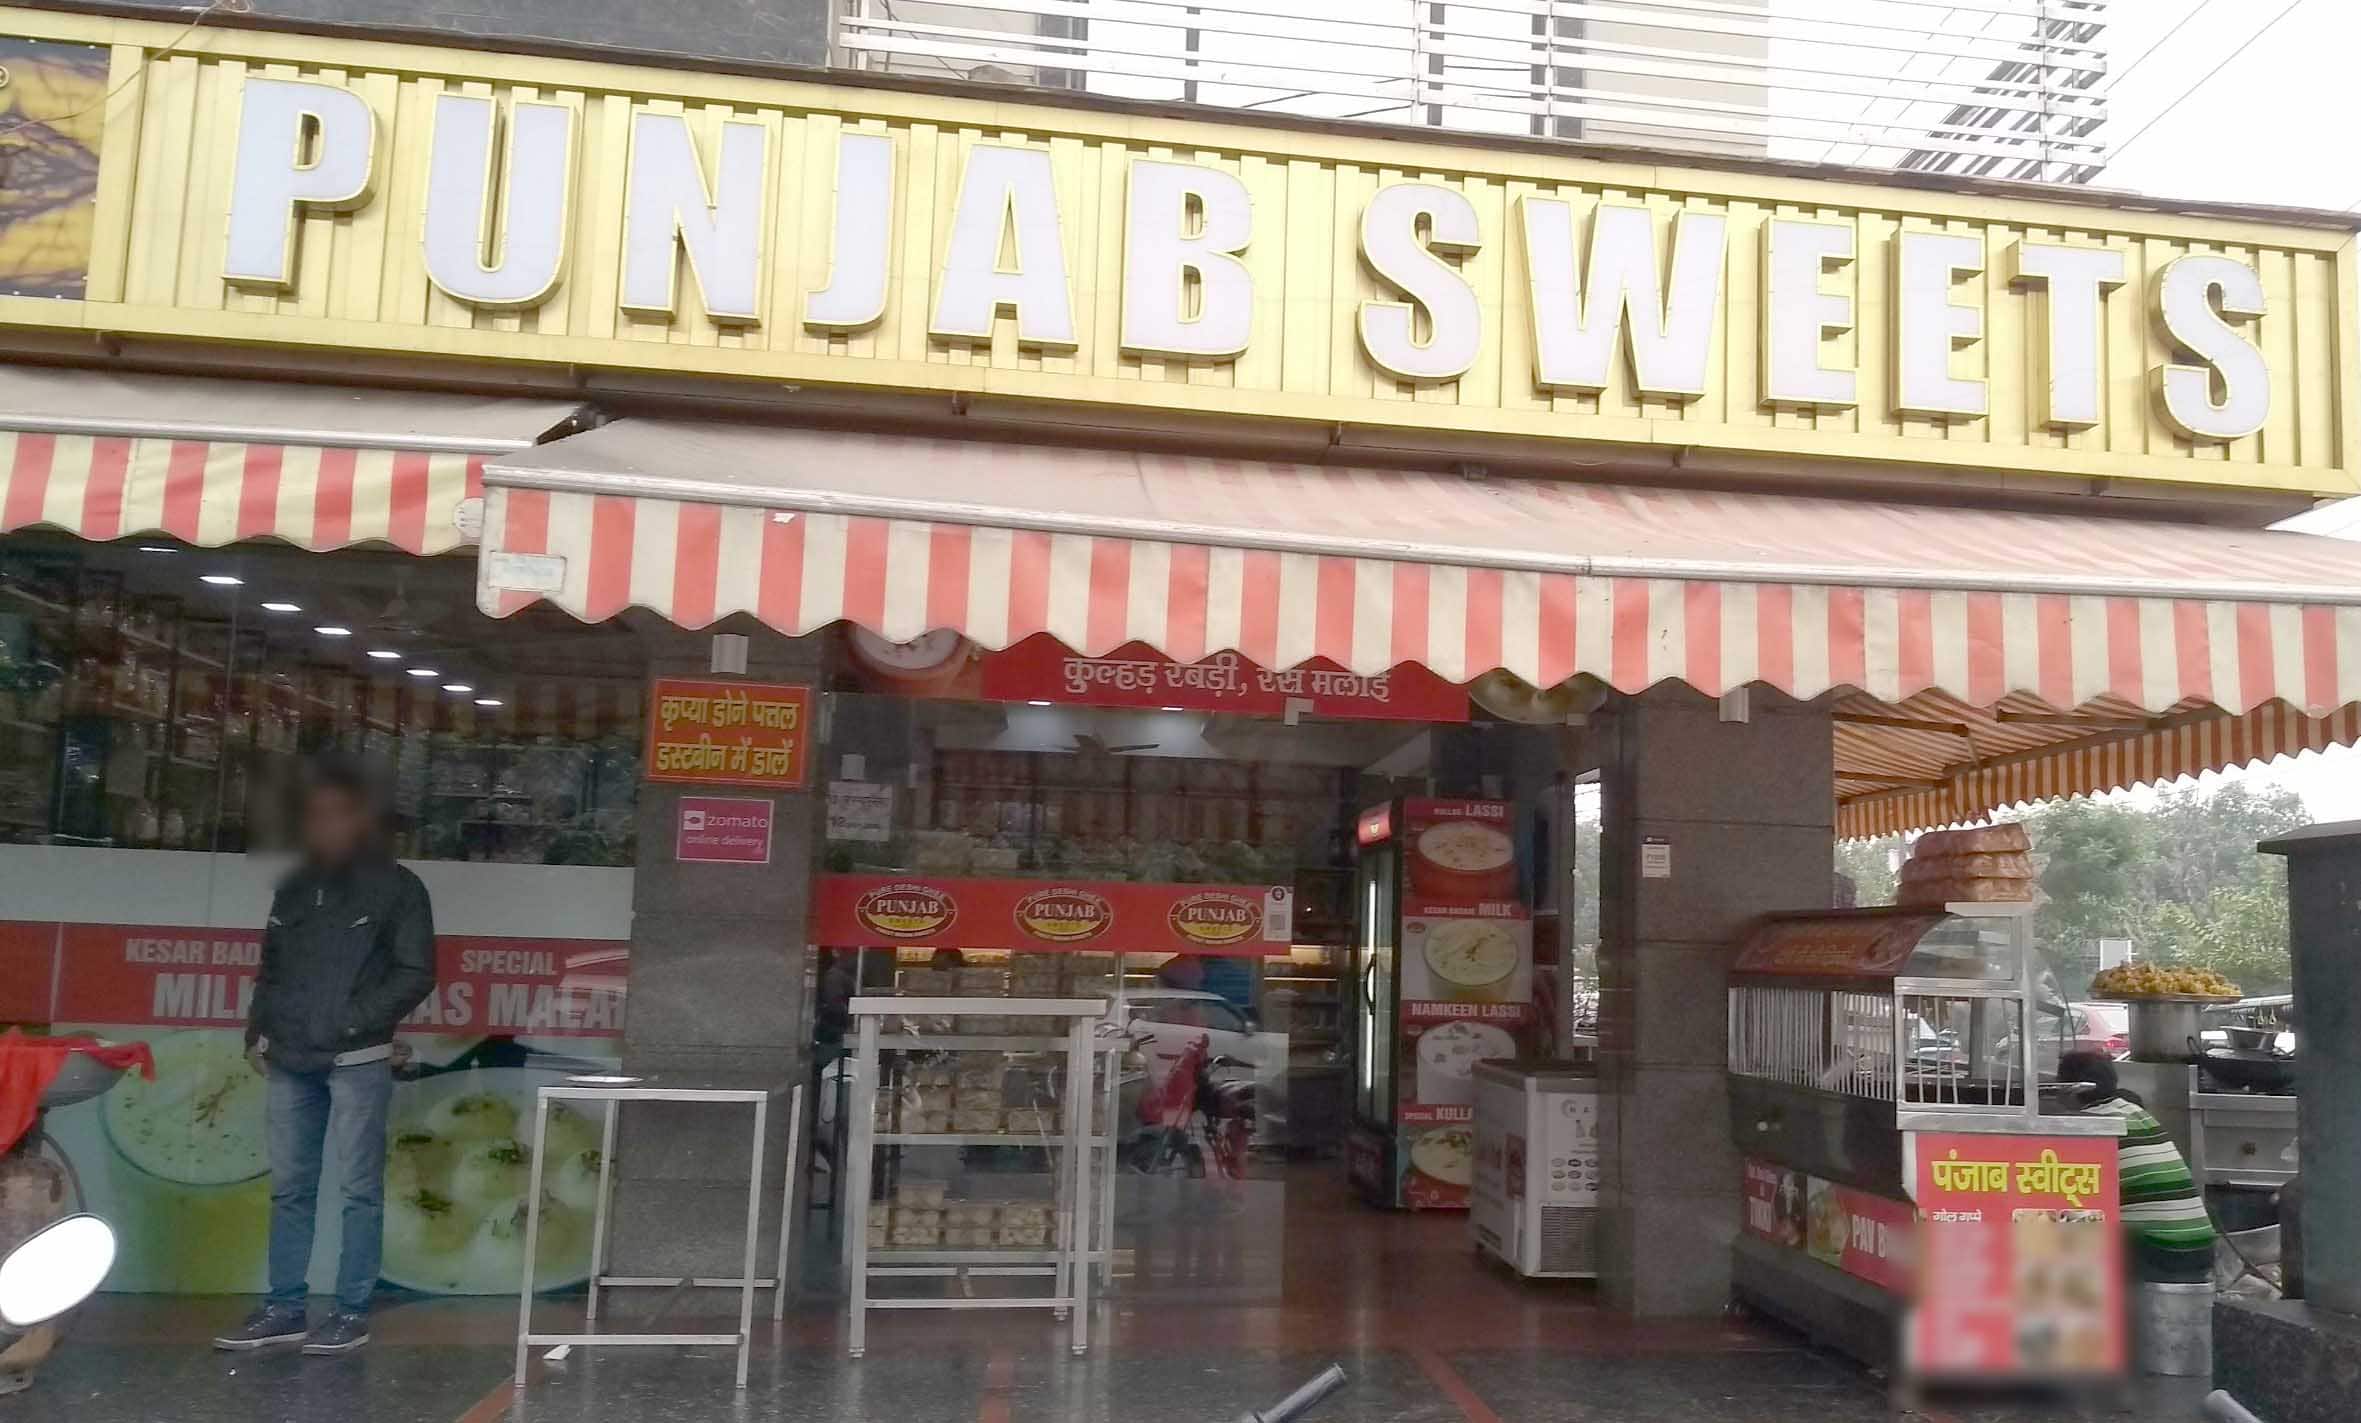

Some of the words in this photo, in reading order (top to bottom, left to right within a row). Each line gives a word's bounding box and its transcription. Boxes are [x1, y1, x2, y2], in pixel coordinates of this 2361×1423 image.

[221, 75, 1254, 358] PUNJAB
[1357, 182, 2271, 444] SWEETS
[1064, 657, 1158, 694] कुल्हड़
[1257, 668, 1304, 694] रस
[657, 733, 729, 770] डस्टबीन
[731, 736, 753, 771] में
[752, 738, 795, 776] डालें
[707, 815, 769, 829] zomato
[686, 834, 719, 846] online
[720, 834, 765, 850] delivery
[876, 899, 939, 915] PUNJAB
[1034, 903, 1096, 918] PUNJAB
[1187, 907, 1247, 923] PUNJAB
[1478, 903, 1512, 917] MILK
[126, 938, 205, 964] KESAR
[212, 941, 264, 966] BAD
[461, 950, 557, 976] SPECIAL
[400, 981, 474, 1027] AS
[1412, 1003, 1478, 1018] NAMKEEN
[1931, 1149, 2010, 1192] पंजाब
[2015, 1148, 2102, 1207] स्वीट्स
